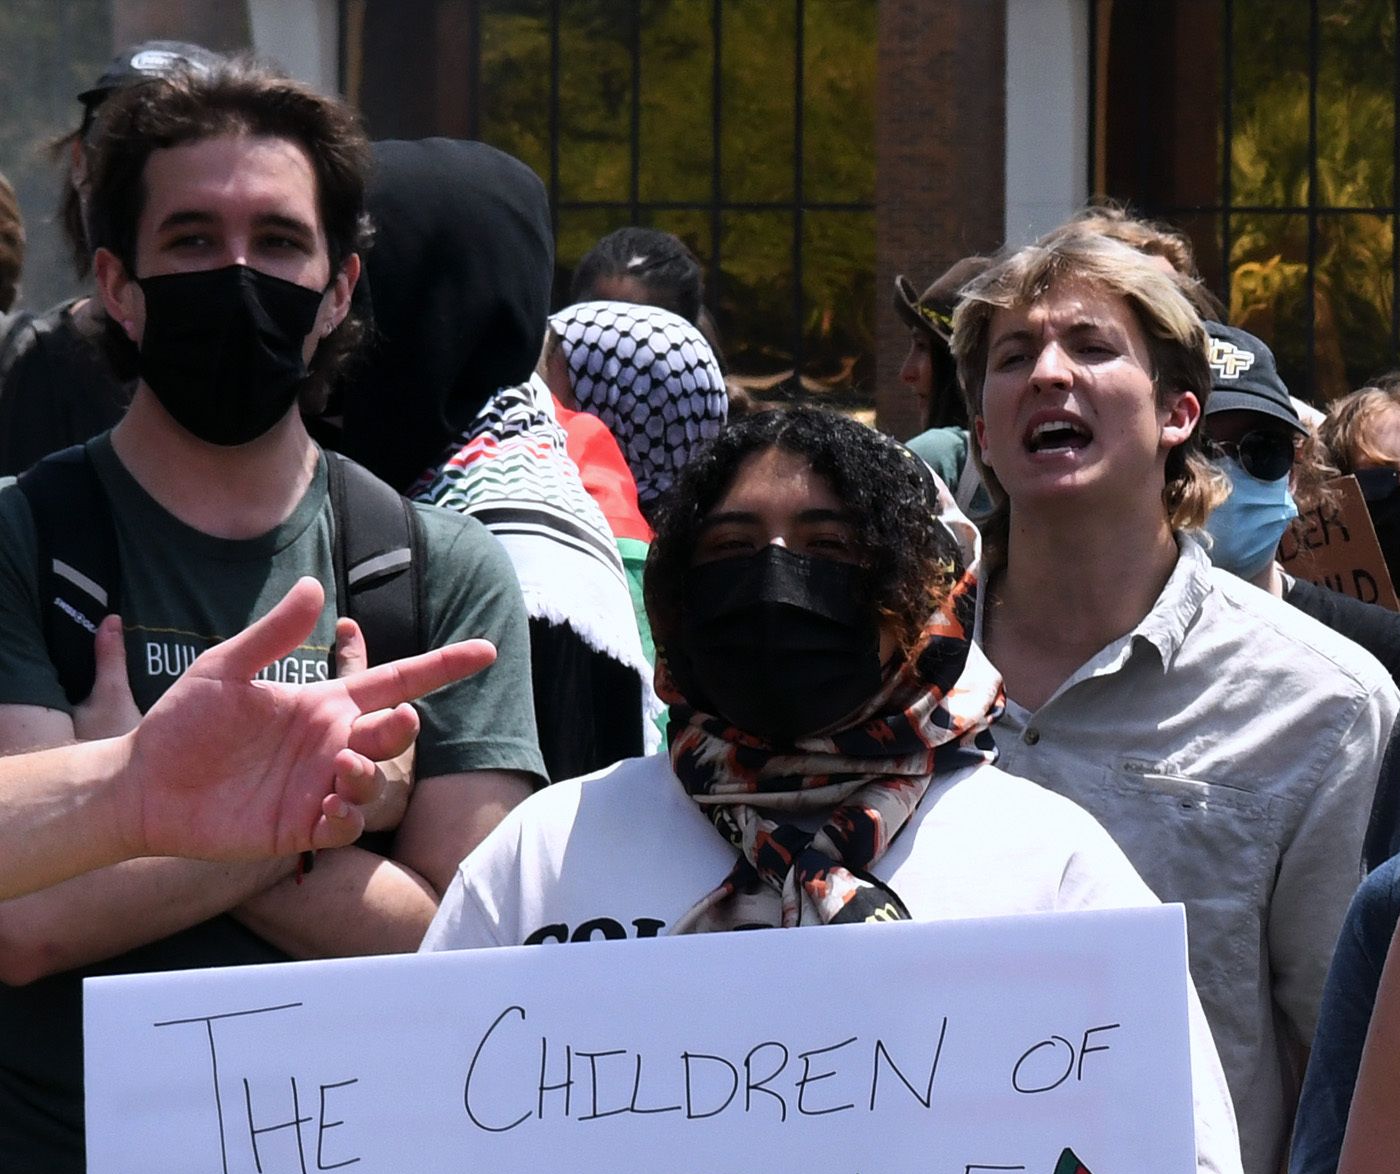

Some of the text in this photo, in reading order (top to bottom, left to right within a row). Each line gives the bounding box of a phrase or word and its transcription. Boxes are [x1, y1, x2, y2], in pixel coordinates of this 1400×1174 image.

[1208, 338, 1255, 379] CF
[465, 1006, 947, 1132] CHILDREN
[1013, 1024, 1120, 1094] OF
